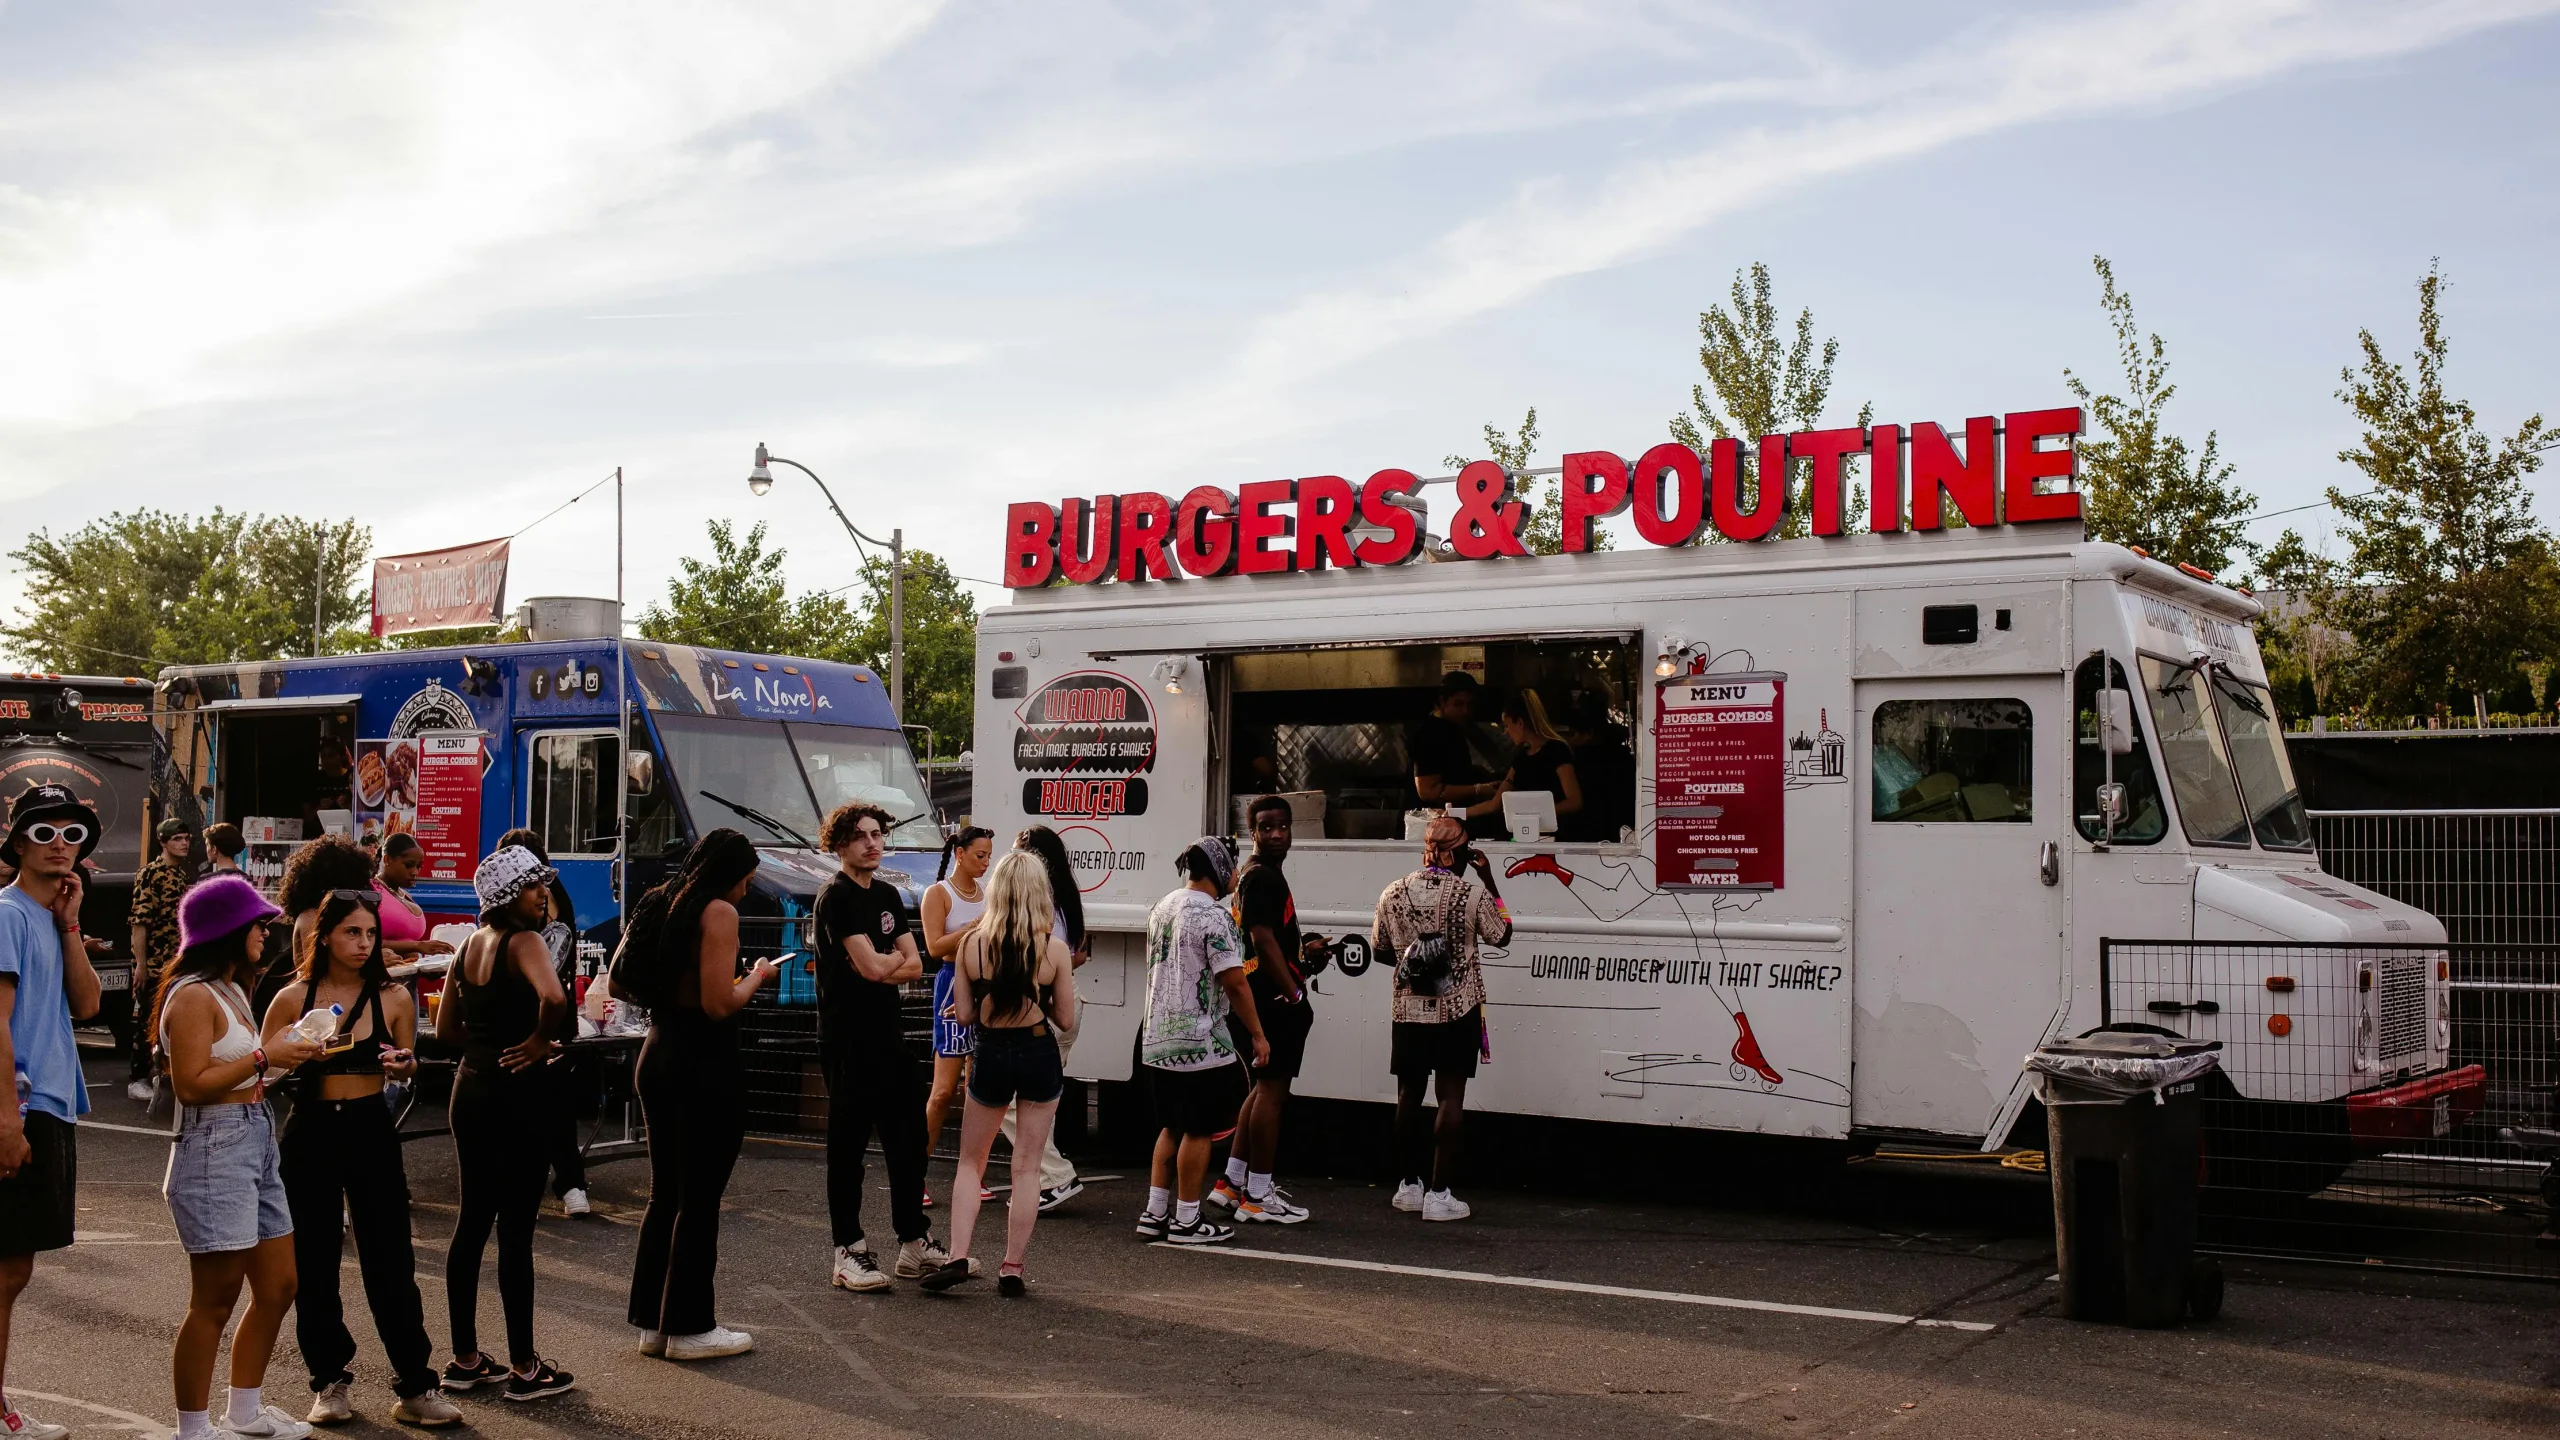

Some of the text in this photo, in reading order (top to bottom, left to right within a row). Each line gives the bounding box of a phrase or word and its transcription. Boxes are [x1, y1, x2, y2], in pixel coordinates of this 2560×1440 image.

[1003, 407, 2086, 589] BURGERS & POUTINE
[376, 560, 507, 616] BURGERS POUTINES WATE
[712, 673, 748, 700] La
[1690, 686, 1747, 701] MENU
[79, 702, 148, 722] TRUCK
[1044, 688, 1127, 722] WANNA
[1662, 710, 1773, 724] BURGER COMBOS
[437, 739, 466, 749] MENU
[1018, 742, 1152, 758] FRESH MADE BURGERS & SHAKES
[423, 756, 478, 765] BURGER COMBOS
[5, 758, 102, 787] ULTIMATE FOOD TRUCK
[1684, 783, 1745, 793] POUTINES
[1040, 780, 1126, 821] BURGER
[431, 806, 461, 815] POUTINES
[245, 858, 282, 877] Fusion
[1066, 850, 1145, 871] URGERTO.COM
[431, 870, 457, 878] WATER
[1689, 873, 1740, 885] WATER
[1531, 954, 1842, 991] WANNA BURGER WITH THAT SHAKE?
